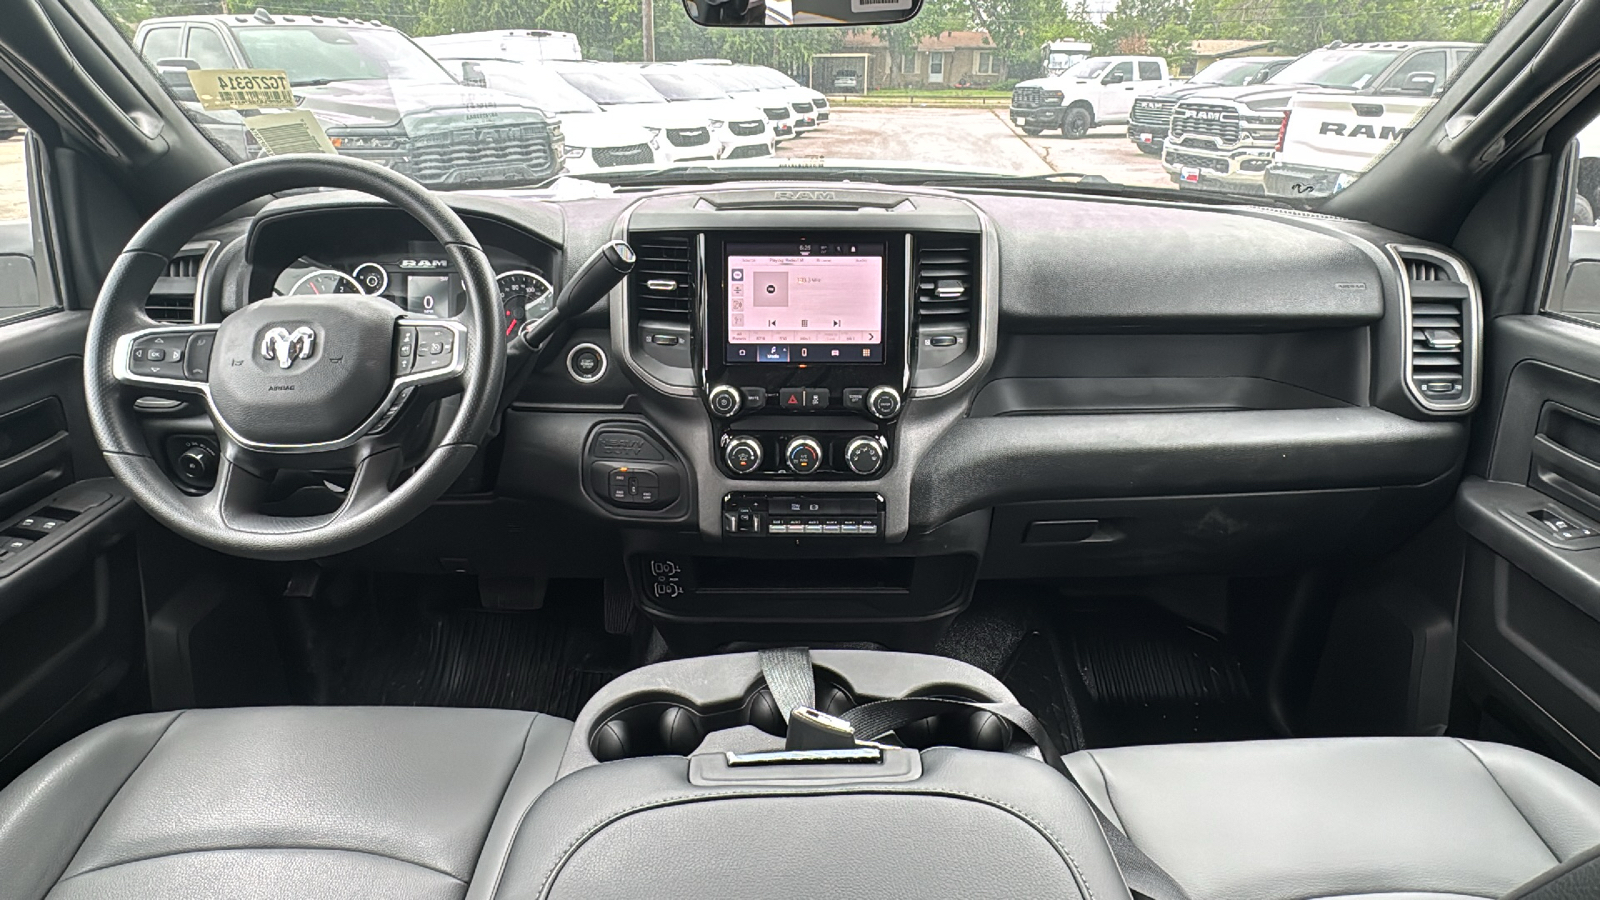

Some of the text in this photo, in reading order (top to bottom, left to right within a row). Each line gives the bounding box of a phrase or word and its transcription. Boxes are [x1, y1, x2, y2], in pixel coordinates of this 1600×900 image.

[1186, 110, 1221, 121] RAM
[1319, 121, 1411, 141] RAM
[774, 191, 836, 200] RAM
[402, 259, 448, 268] RAM
[423, 295, 434, 309] 0
